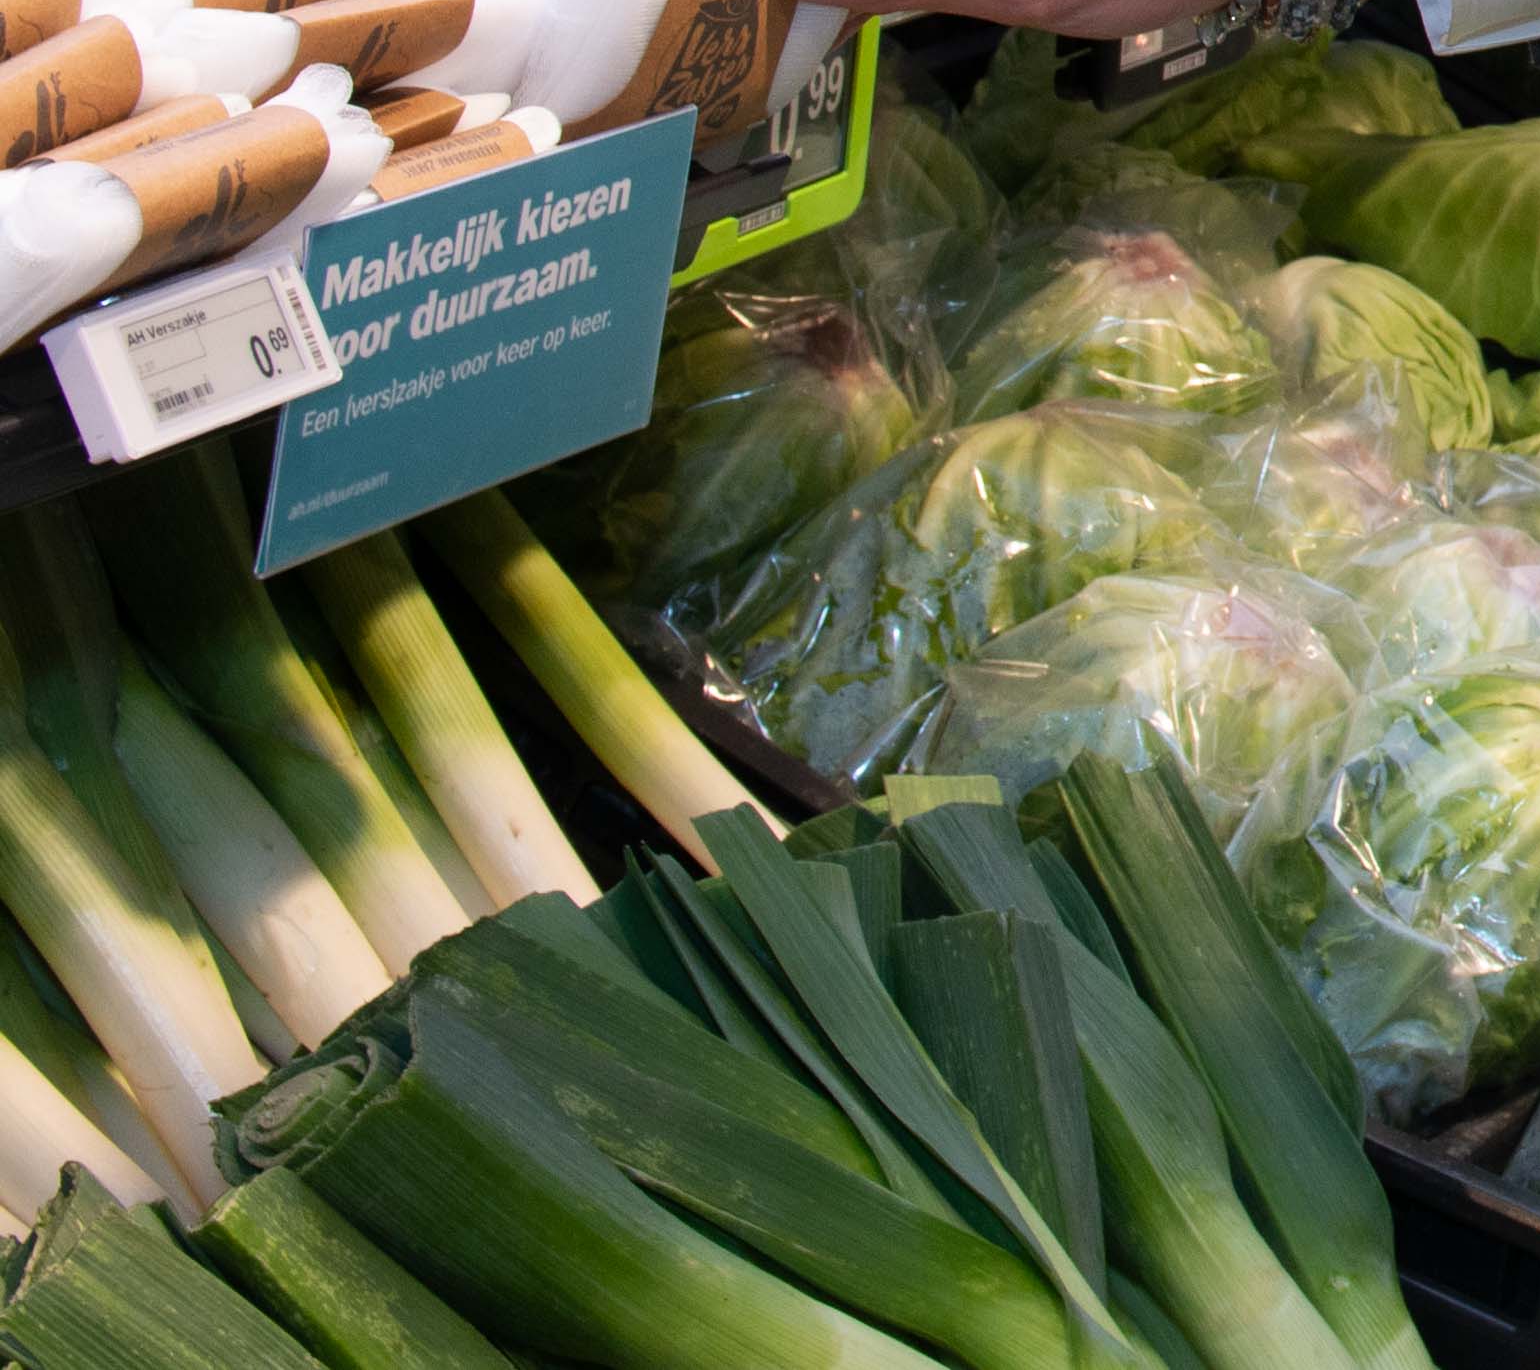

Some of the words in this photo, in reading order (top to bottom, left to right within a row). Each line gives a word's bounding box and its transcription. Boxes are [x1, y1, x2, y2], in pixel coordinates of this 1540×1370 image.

[320, 210, 507, 310] Makkelijk
[516, 176, 632, 246] kiezen
[409, 247, 598, 340] duurzaam.
[127, 332, 146, 347] AH
[149, 310, 207, 339] Verszakje
[301, 407, 338, 439] Een
[345, 365, 446, 427] (vers)zakje
[450, 348, 493, 385] voor
[496, 334, 540, 367] keer
[543, 329, 565, 353] op
[569, 307, 613, 342] keer.
